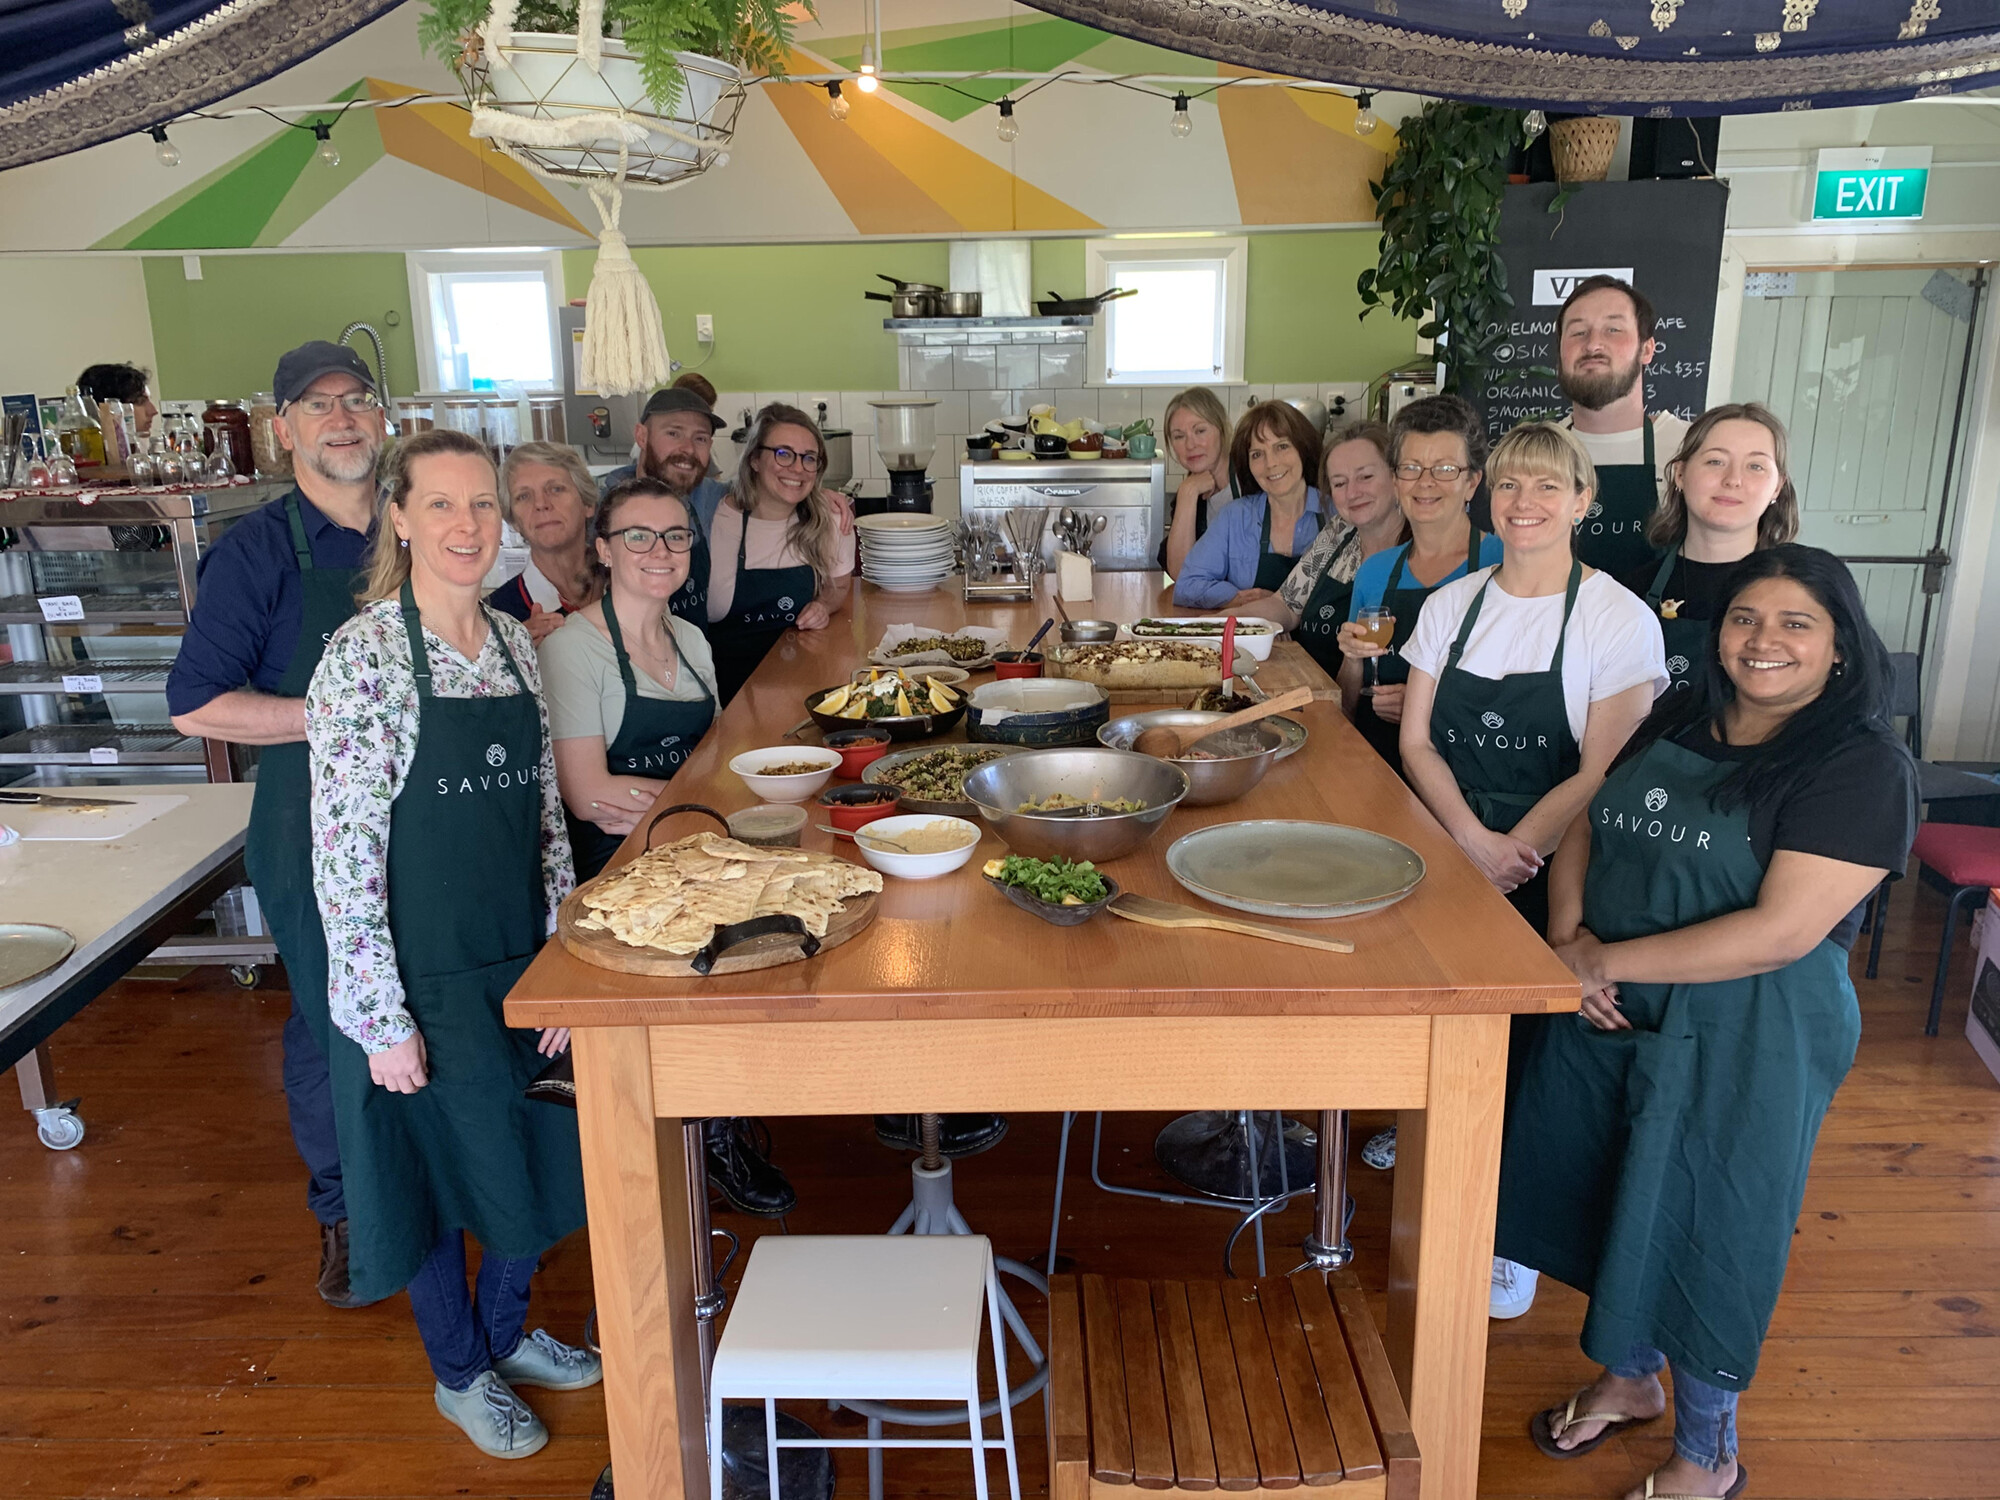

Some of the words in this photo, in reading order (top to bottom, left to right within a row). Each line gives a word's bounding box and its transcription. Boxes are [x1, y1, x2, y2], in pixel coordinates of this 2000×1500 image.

[1836, 176, 1904, 212] EXIT
[1654, 317, 1686, 331] AFE
[1516, 344, 1549, 359] SIX
[1644, 363, 1671, 377] ACK
[1487, 384, 1562, 399] ORGANIC
[1488, 405, 1573, 419] SMOOTHES
[1575, 520, 1642, 536] VOUR
[1447, 729, 1548, 749] SVOUR
[437, 765, 540, 795] SAVOUR
[1602, 807, 1711, 850] SAVOUR
